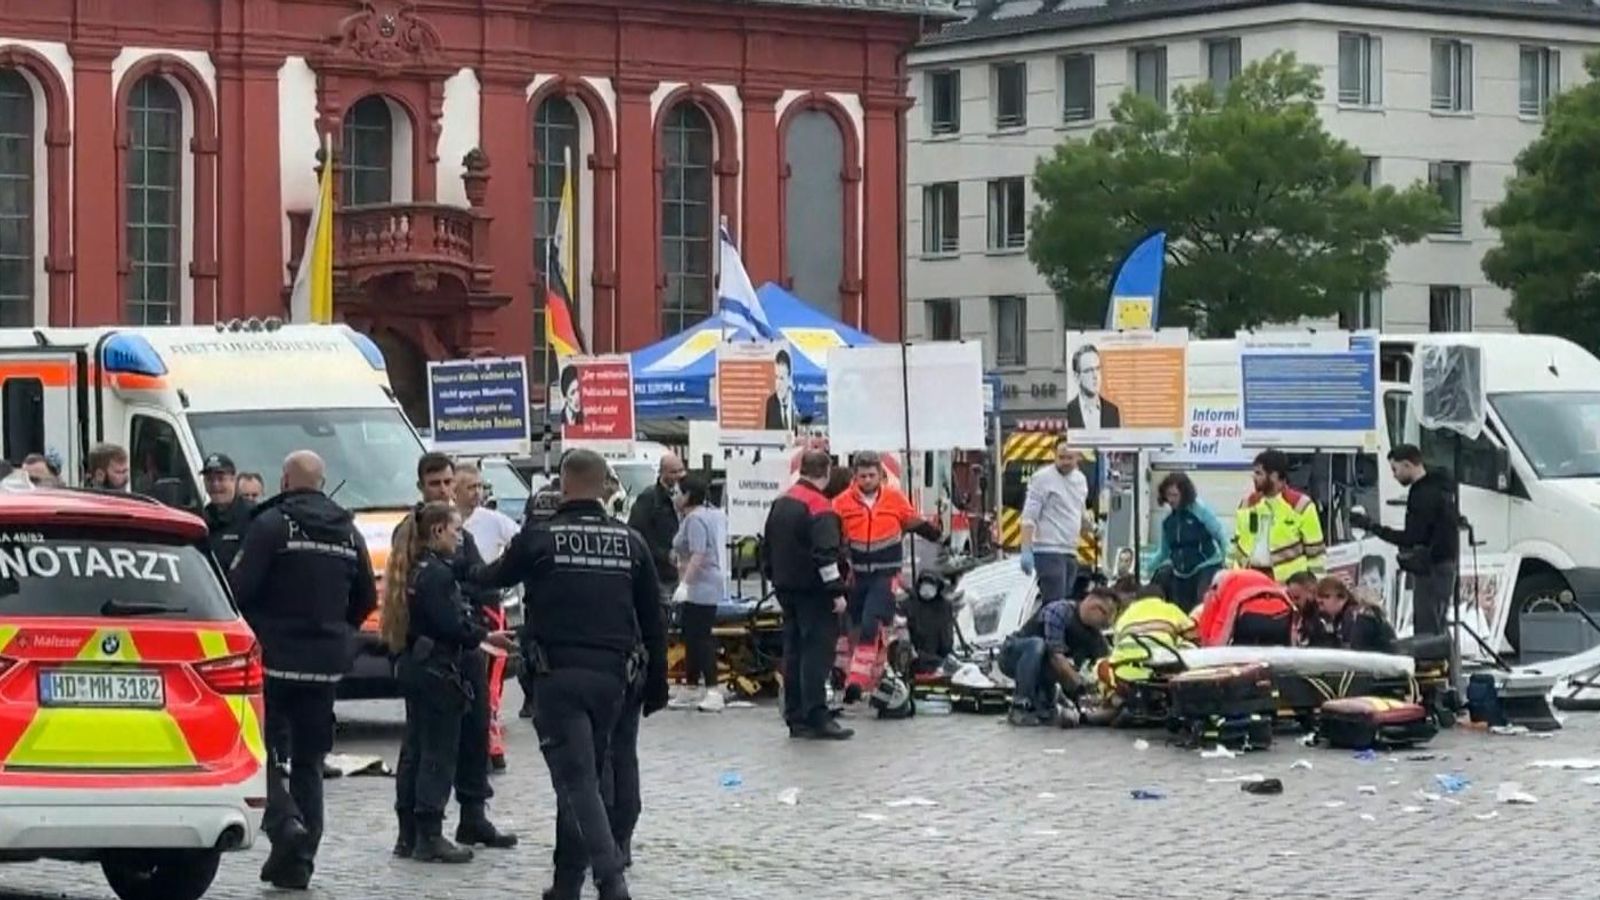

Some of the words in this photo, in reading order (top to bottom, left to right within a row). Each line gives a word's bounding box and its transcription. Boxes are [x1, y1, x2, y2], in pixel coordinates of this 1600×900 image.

[437, 417, 492, 431] Politischen
[493, 416, 522, 429] Islam
[1191, 424, 1211, 438] Sie
[1214, 423, 1241, 438] sich
[1189, 440, 1219, 455] hier!
[554, 532, 631, 557] POLIZEI
[0, 545, 181, 584] NOTARZT
[33, 635, 81, 649] Malteser
[117, 677, 162, 700] 3182
